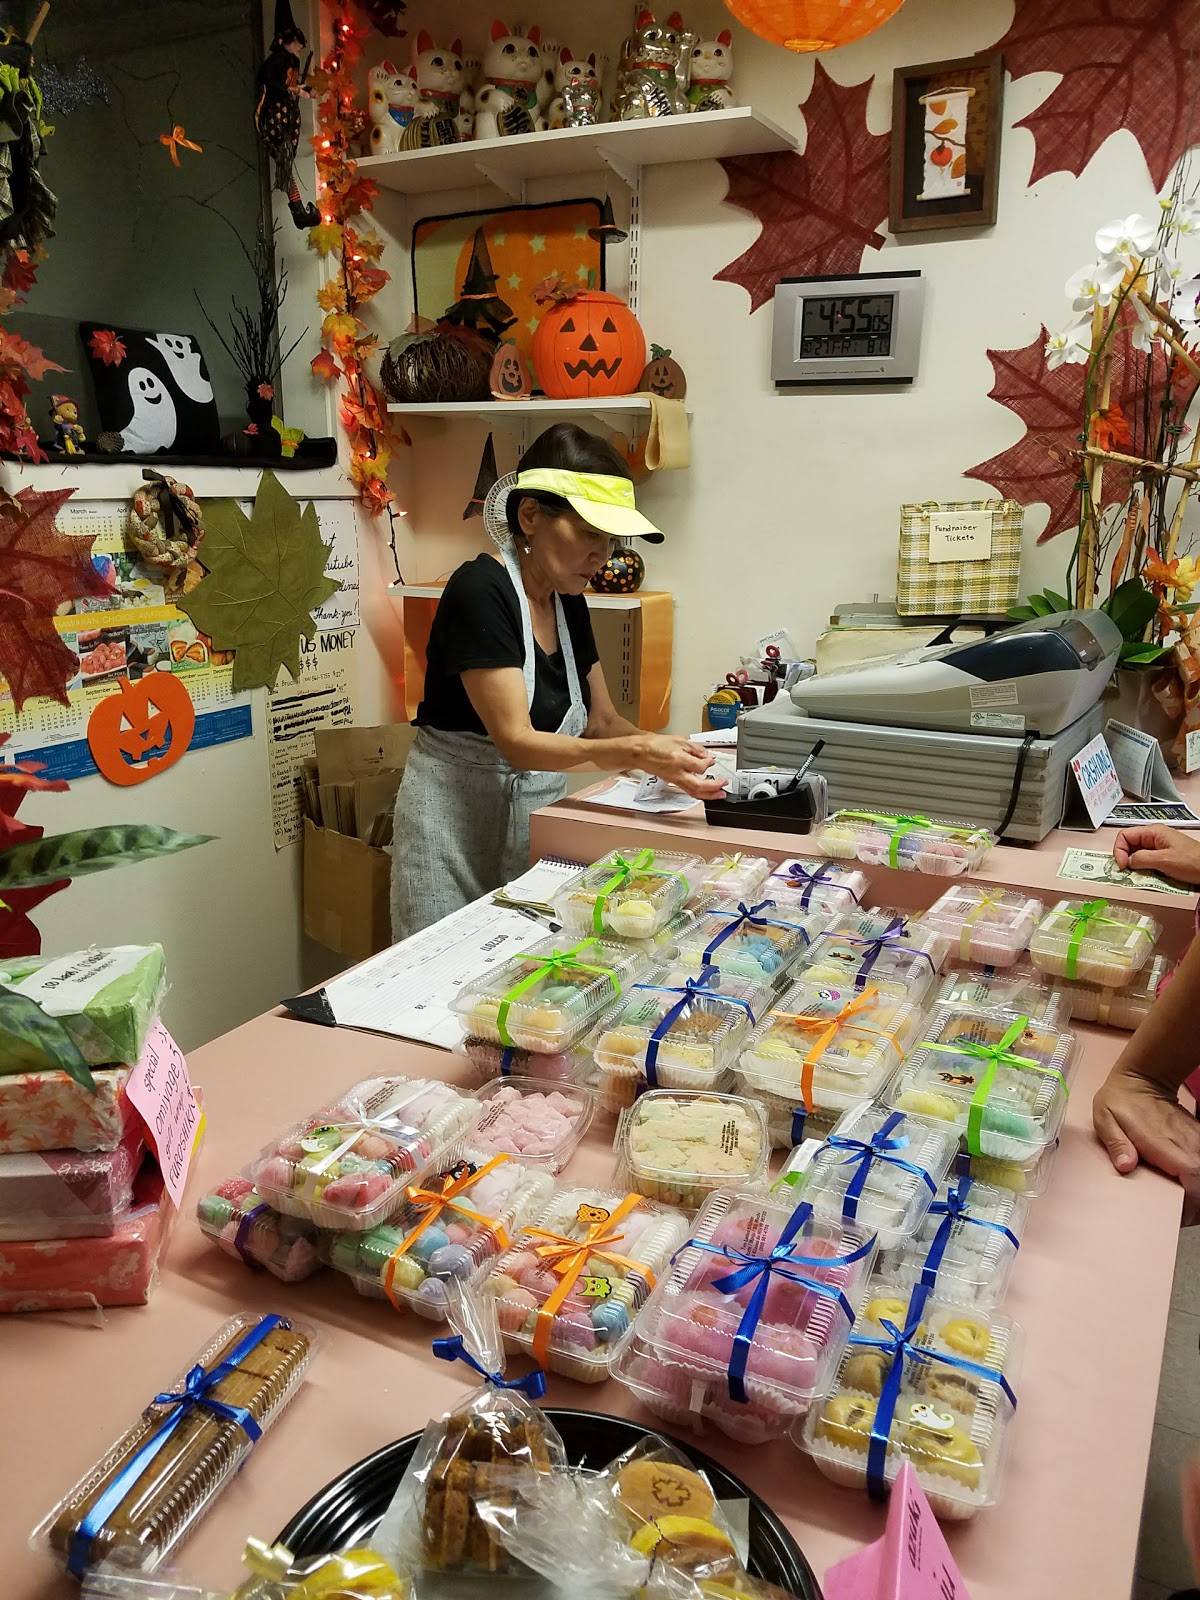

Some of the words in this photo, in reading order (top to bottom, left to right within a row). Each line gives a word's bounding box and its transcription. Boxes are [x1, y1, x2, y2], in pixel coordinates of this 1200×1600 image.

[819, 300, 871, 333] 4:55
[935, 524, 977, 533] Fundraiser
[325, 555, 353, 572] utube
[320, 629, 356, 653] MONEY
[155, 1062, 180, 1136] omiyage
[169, 1104, 196, 1189] FUROSHIKI
